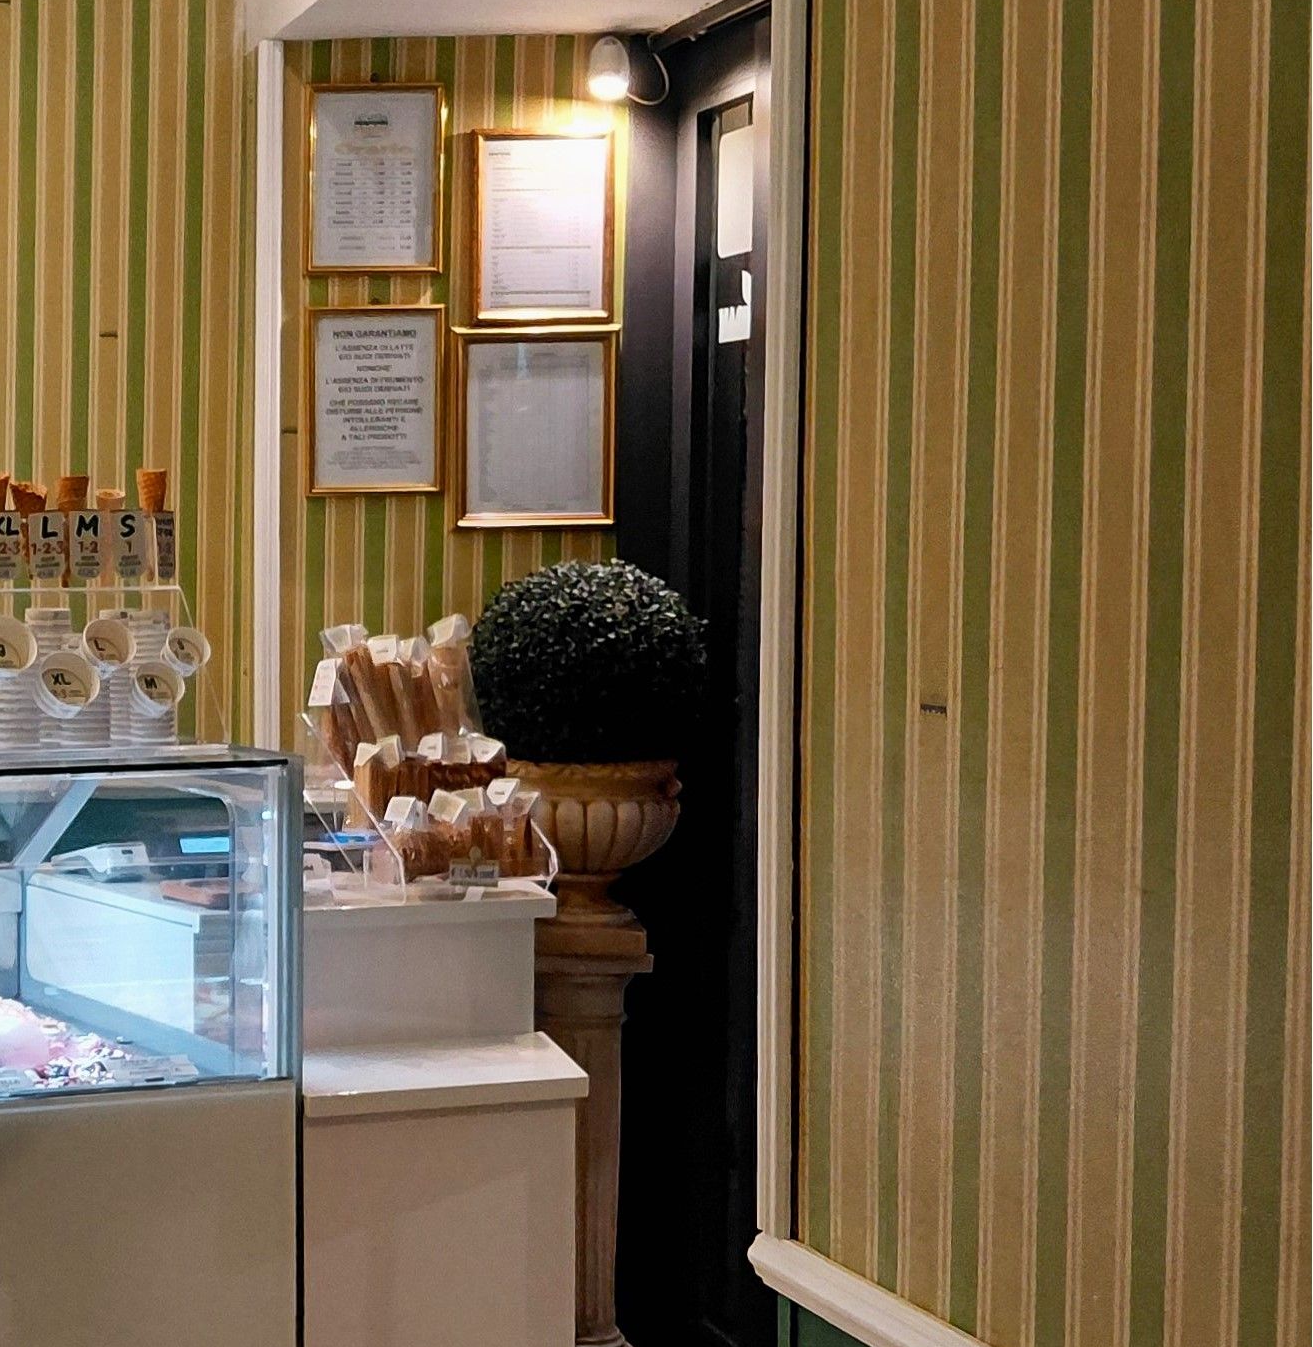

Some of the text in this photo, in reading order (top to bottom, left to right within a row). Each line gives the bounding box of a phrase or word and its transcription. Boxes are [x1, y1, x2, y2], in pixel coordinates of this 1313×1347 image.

[355, 329, 417, 338] GARANTIAMO
[42, 515, 58, 539] L
[75, 515, 99, 537] M
[120, 514, 136, 538] S
[94, 639, 106, 652] L
[51, 672, 72, 687] XL
[144, 677, 158, 690] M
